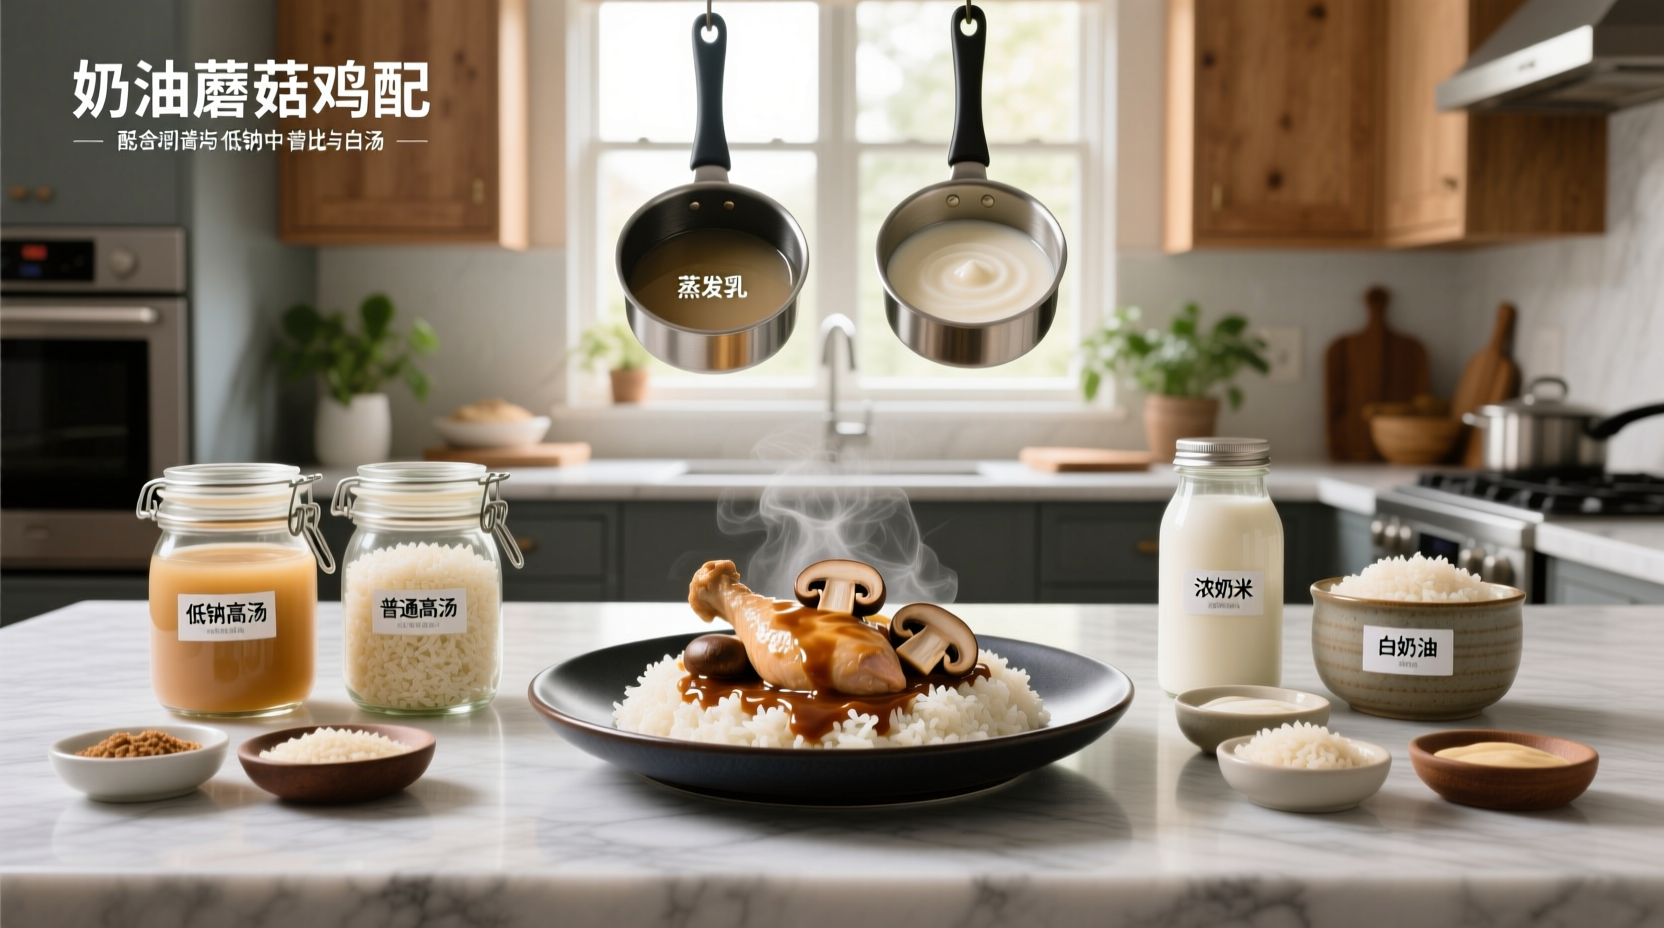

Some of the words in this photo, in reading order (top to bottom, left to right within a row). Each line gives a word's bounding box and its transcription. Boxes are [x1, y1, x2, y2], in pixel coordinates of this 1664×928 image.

[1194, 576, 1253, 600] 浓奶米
[186, 601, 267, 625] 低钠高汤
[380, 597, 457, 619] 普通高汤
[1379, 635, 1438, 658] 白奶油
